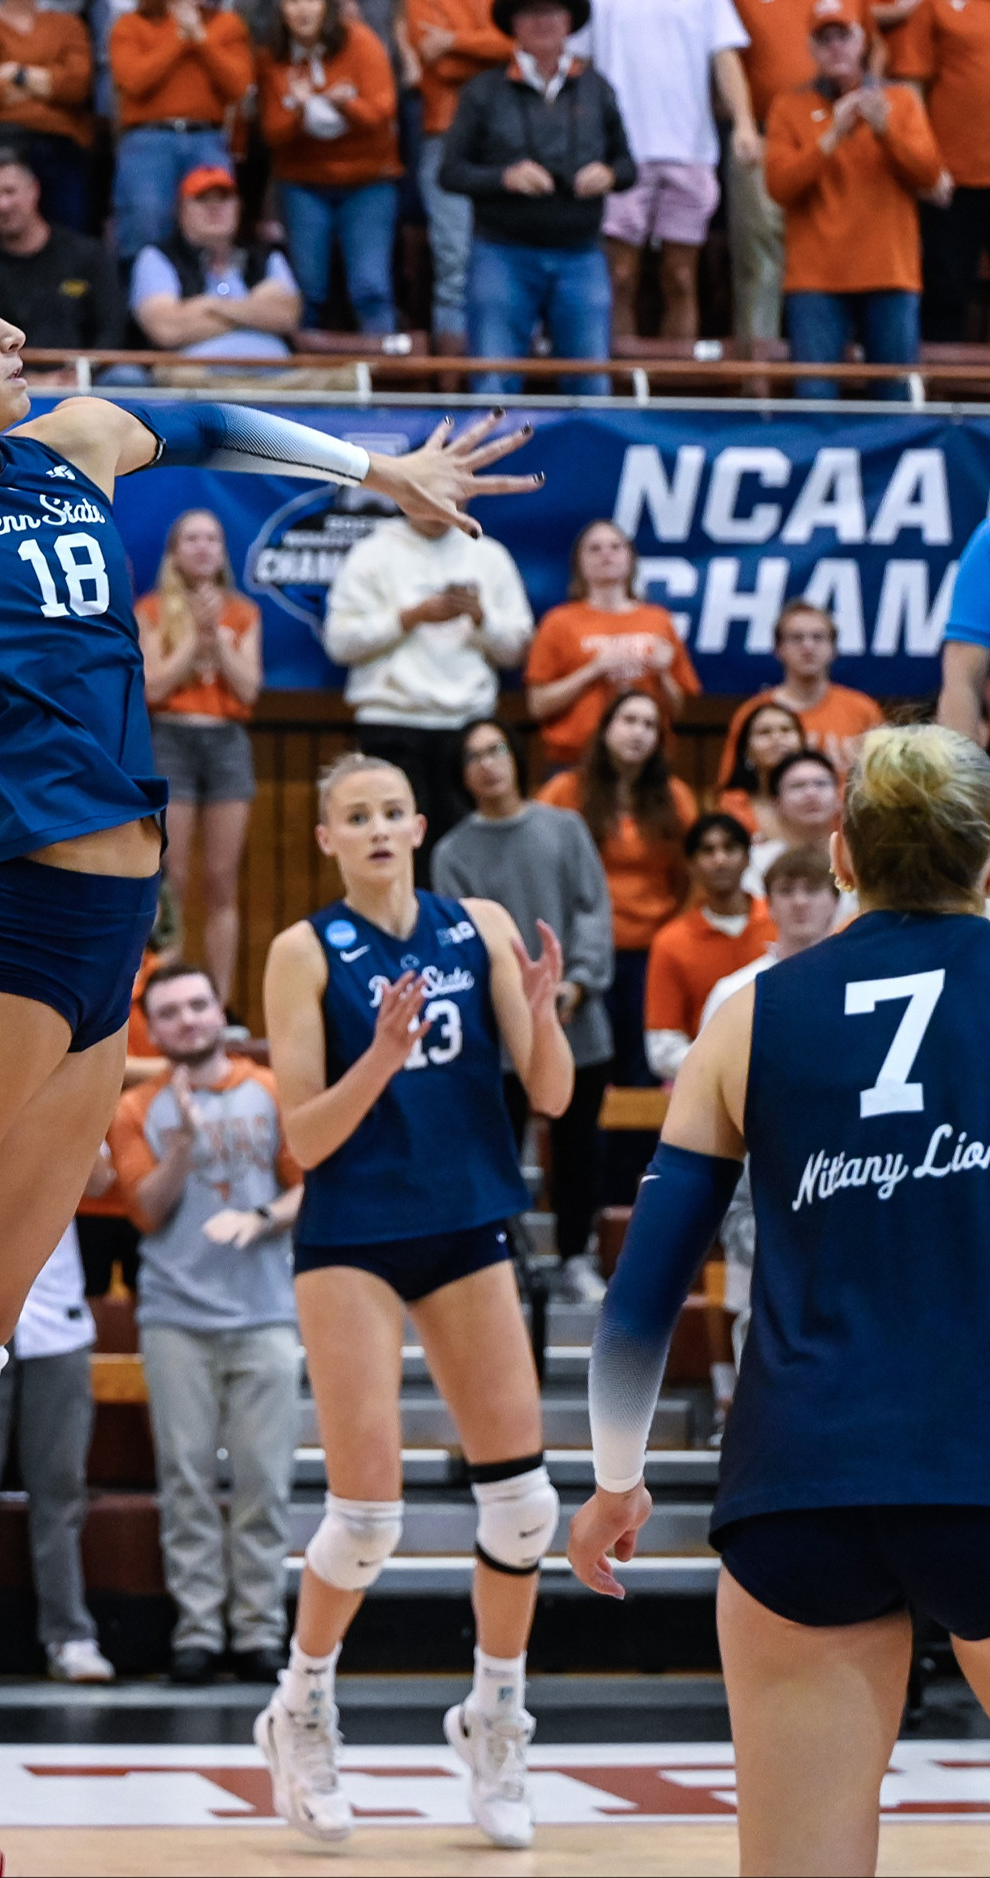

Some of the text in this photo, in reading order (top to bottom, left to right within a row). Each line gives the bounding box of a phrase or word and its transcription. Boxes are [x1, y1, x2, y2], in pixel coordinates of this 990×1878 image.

[39, 494, 106, 526] State
[612, 444, 953, 545] NCAA
[17, 532, 110, 618] 18
[404, 999, 463, 1070] 13
[844, 968, 946, 1119] 7
